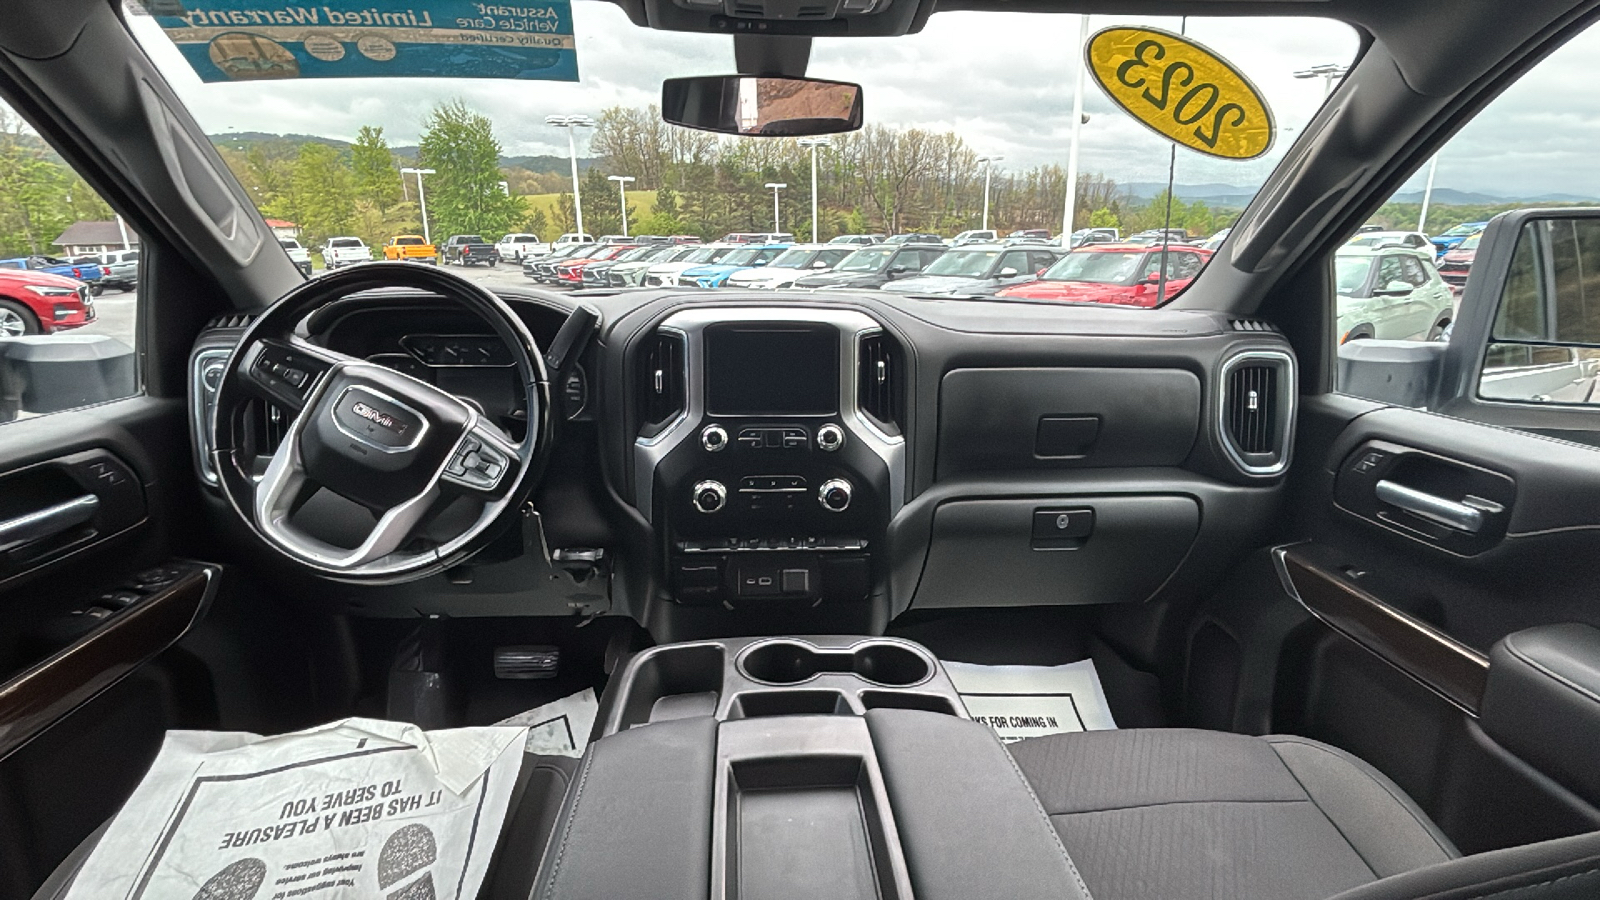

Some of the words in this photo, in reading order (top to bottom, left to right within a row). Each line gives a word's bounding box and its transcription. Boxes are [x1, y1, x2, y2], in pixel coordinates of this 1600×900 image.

[989, 716, 1009, 728] FOR
[1009, 716, 1048, 728] COMING
[1046, 716, 1059, 729] IN
[320, 784, 377, 811] SERVE
[380, 779, 402, 797] TO
[424, 789, 443, 807] IT
[279, 796, 317, 820] YOU
[338, 802, 383, 828] BEEN
[387, 794, 423, 817] HAS
[218, 815, 320, 850] PLEASURE
[324, 812, 336, 831] A
